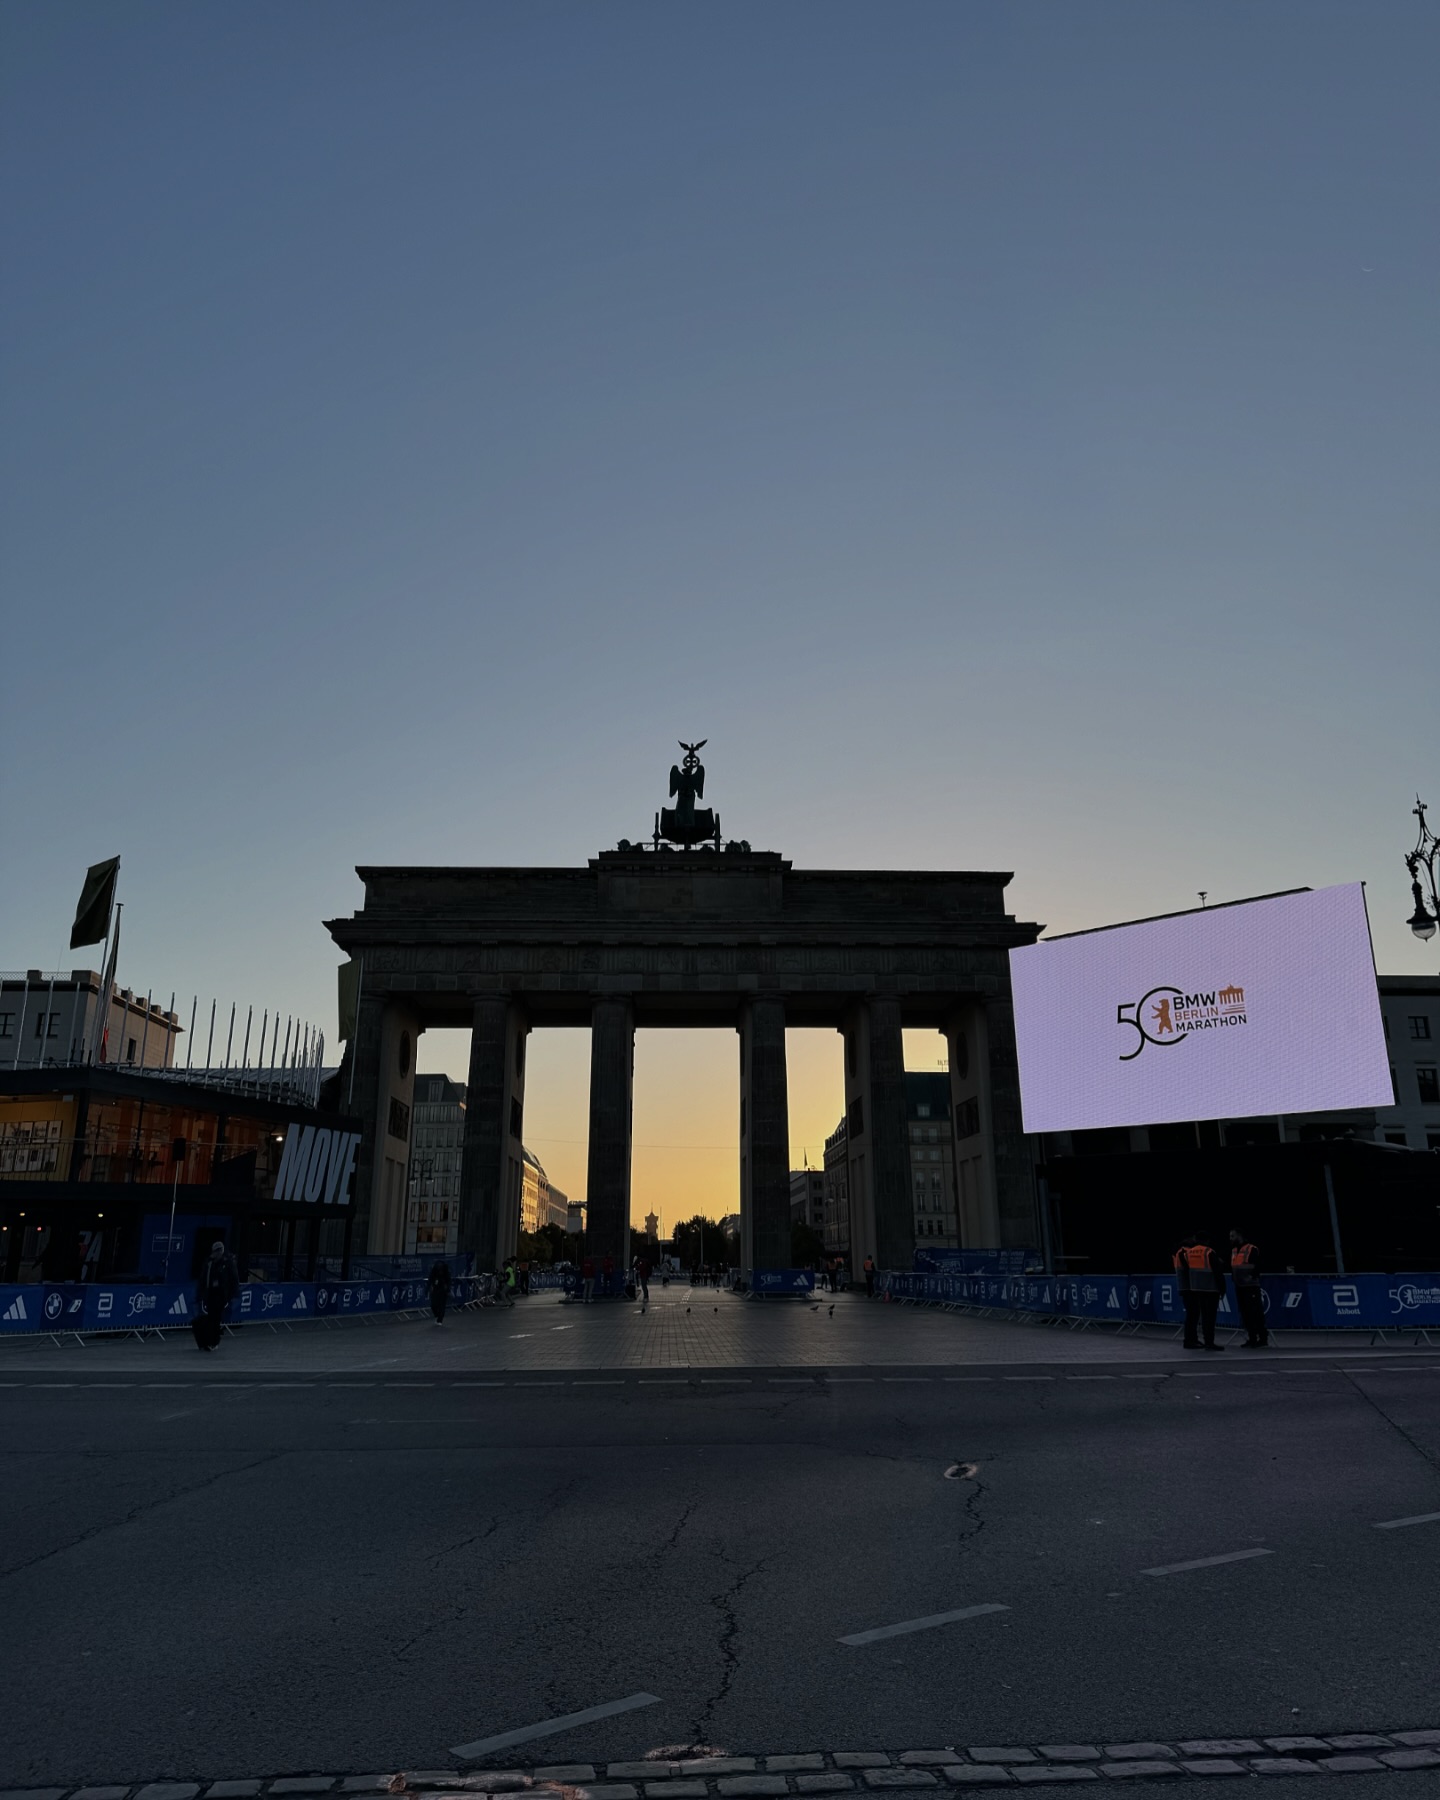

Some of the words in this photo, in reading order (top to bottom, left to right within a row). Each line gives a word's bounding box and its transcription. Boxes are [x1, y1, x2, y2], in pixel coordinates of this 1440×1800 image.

[1173, 991, 1216, 1011] BMW
[1117, 986, 1189, 1061] 50
[1174, 1006, 1219, 1022] BERLIN
[1175, 1014, 1247, 1033] MARATHON
[273, 1122, 363, 1205] MOVE
